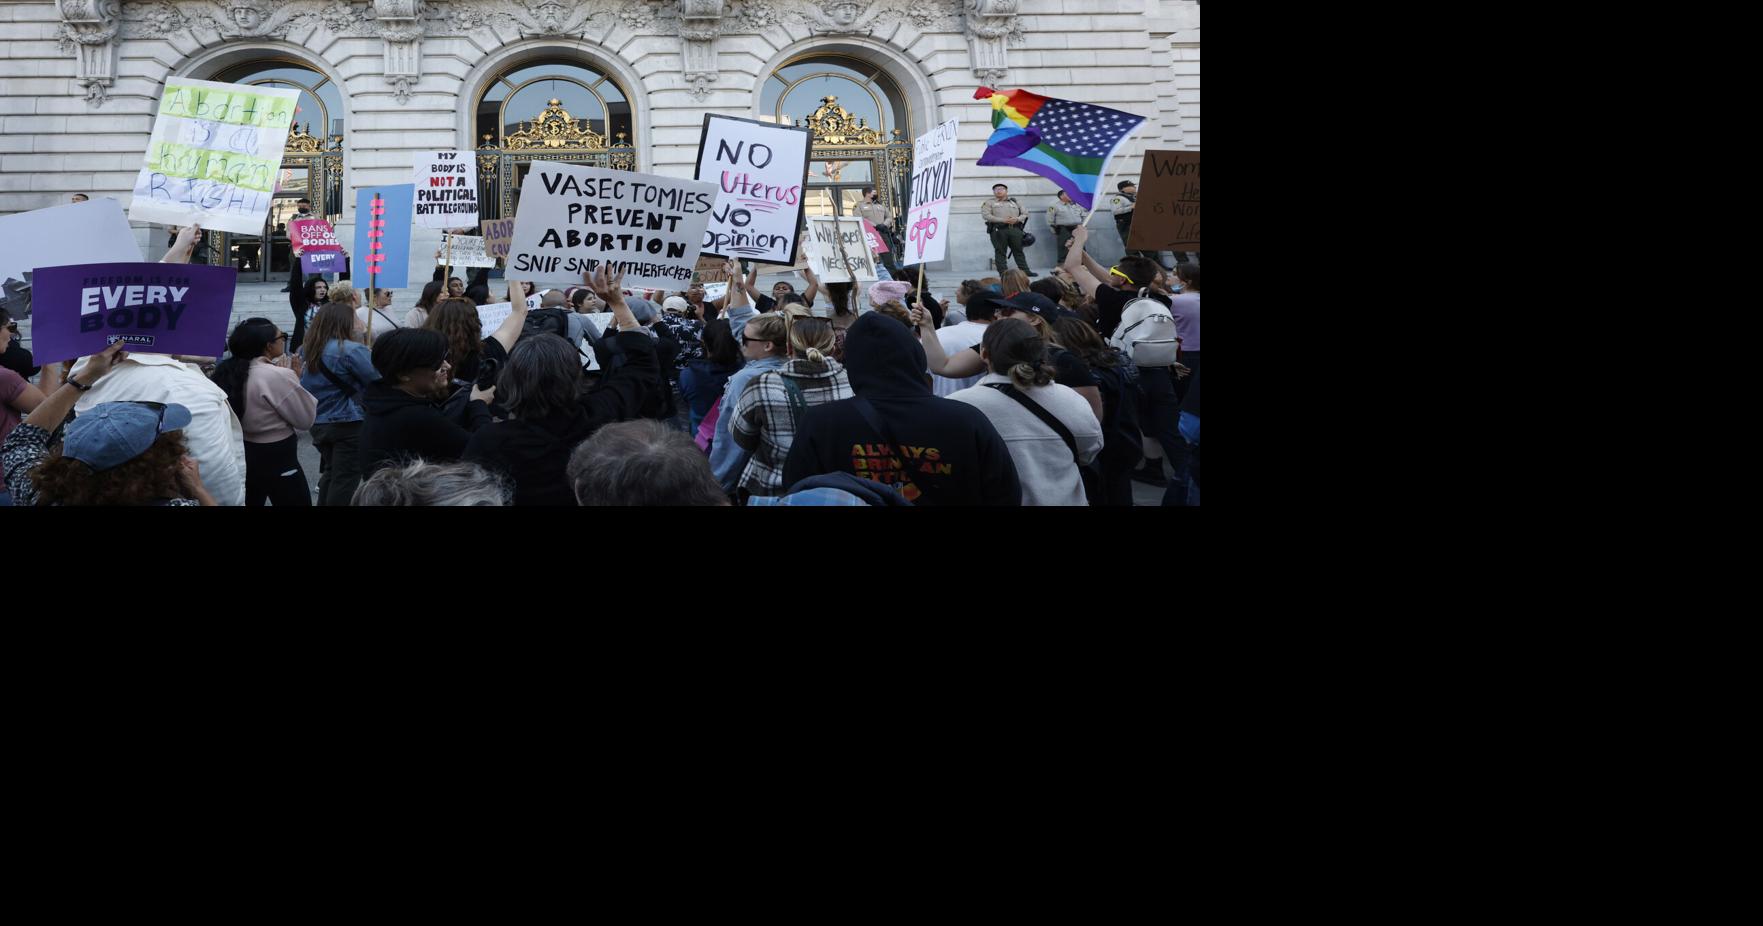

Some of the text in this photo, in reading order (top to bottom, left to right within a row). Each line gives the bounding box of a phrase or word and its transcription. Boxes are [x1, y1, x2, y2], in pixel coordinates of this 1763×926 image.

[169, 89, 287, 124] Abortion
[438, 152, 458, 160] MY
[716, 138, 773, 169] NO
[431, 163, 466, 173] BODY IS
[430, 176, 466, 187] NOT A
[720, 170, 801, 206] Uterus
[932, 157, 953, 202] YOU
[418, 189, 477, 202] POLITICAL
[541, 172, 712, 214] VASECTOMIES
[416, 202, 478, 215] BATTLEGROUND
[568, 203, 683, 232] PREVENT
[301, 224, 329, 233] BANS
[301, 231, 336, 239] OFF OU
[485, 220, 514, 241] ABOR
[538, 228, 687, 258] ABORTION
[311, 254, 335, 263] EVERY
[514, 253, 562, 273] SNIP
[564, 257, 600, 275] SNIP
[82, 276, 190, 286] FREEDOM IS FOR
[81, 285, 190, 316] EVERY
[80, 303, 187, 334] BODY
[121, 335, 152, 343] NARAL
[851, 458, 903, 471] BRIN
